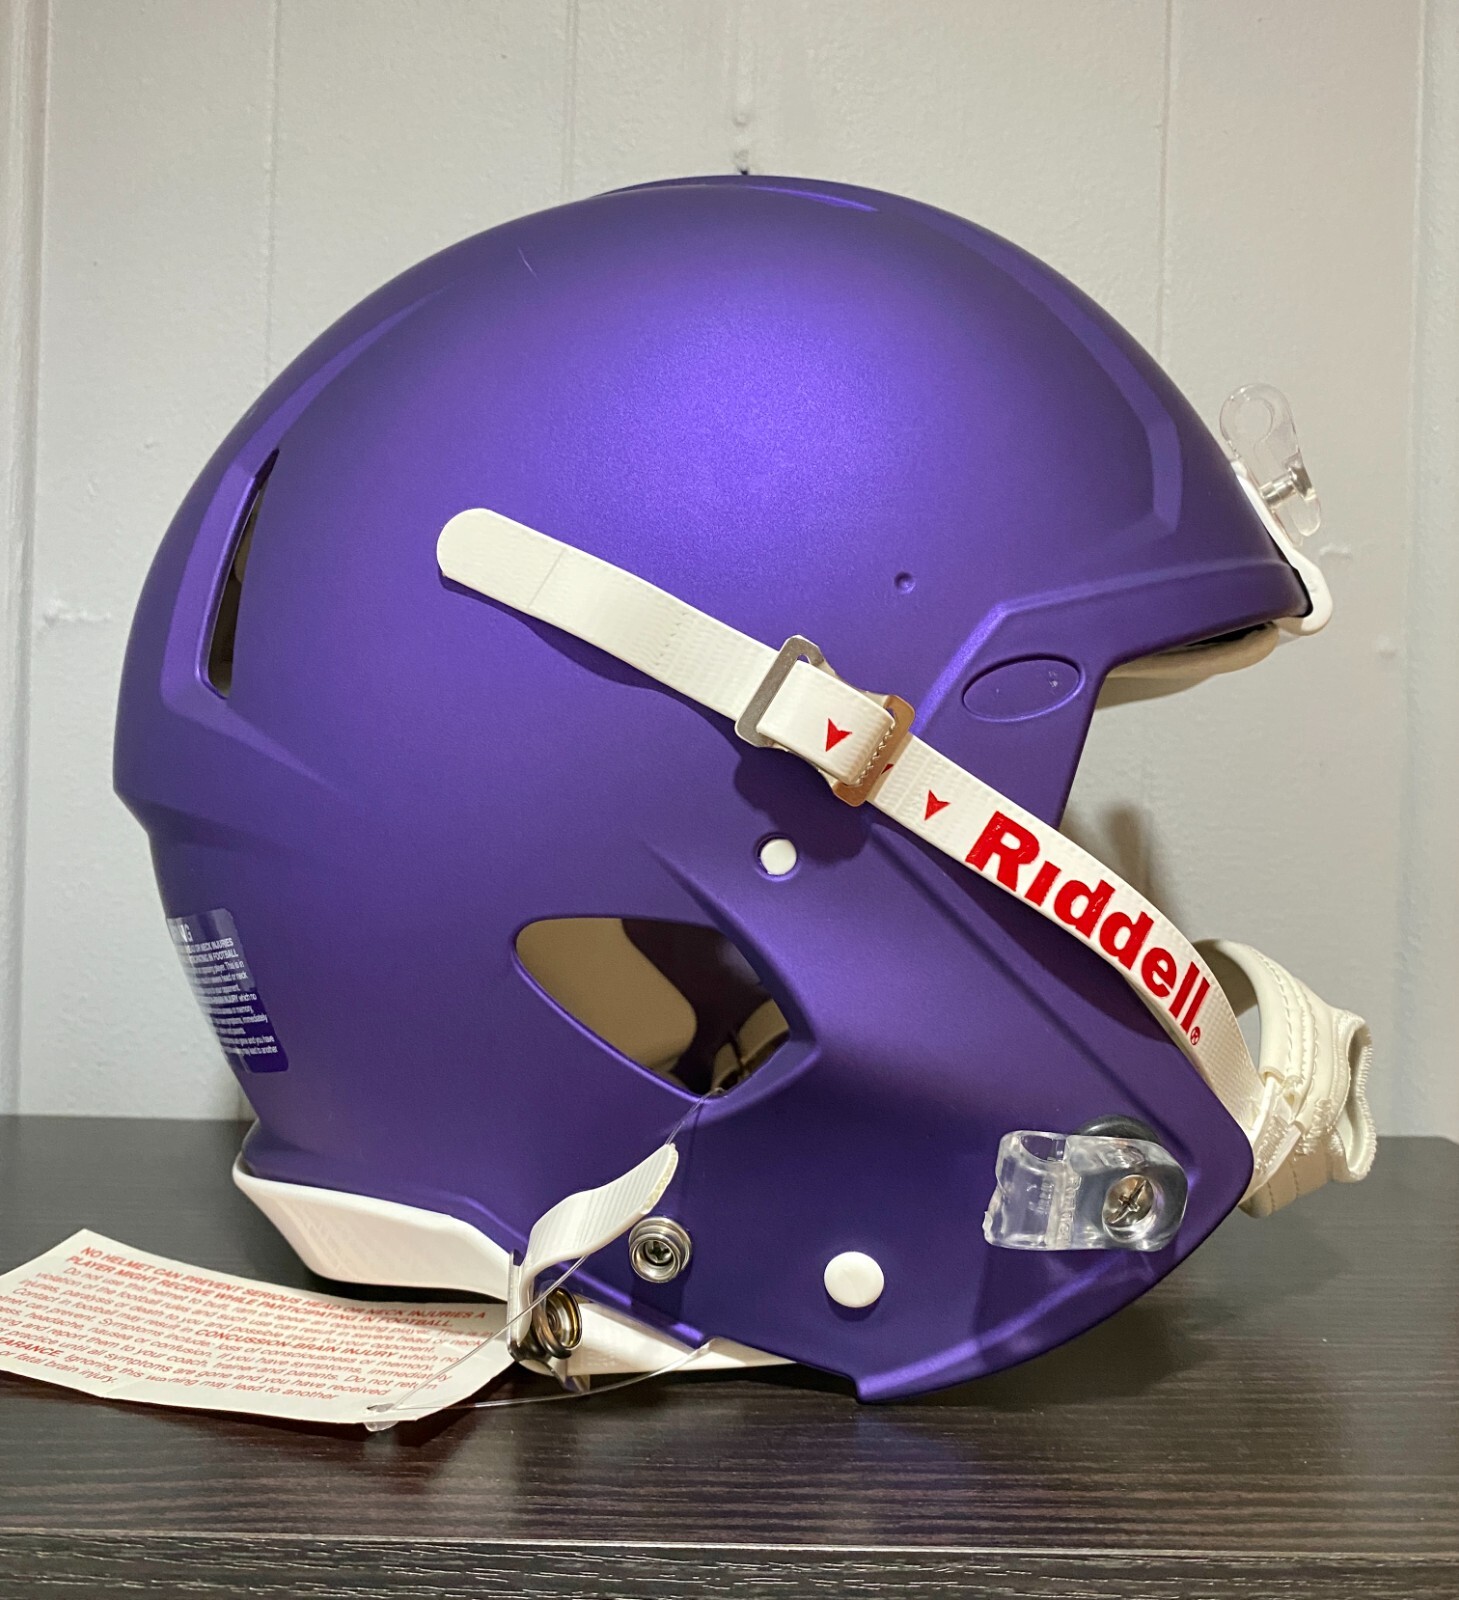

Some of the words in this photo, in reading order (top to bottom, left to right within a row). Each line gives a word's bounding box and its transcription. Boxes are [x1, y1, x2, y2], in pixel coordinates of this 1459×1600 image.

[965, 810, 1210, 1034] Riddell
[35, 1272, 82, 1286] violation
[96, 1286, 117, 1295] the
[116, 1291, 163, 1305] football
[192, 1309, 218, 1317] and
[217, 1314, 247, 1322] such
[248, 1319, 272, 1327] use
[273, 1323, 298, 1331] can
[299, 1327, 336, 1335] result
[351, 1332, 395, 1340] severe
[397, 1335, 433, 1345] head
[63, 1267, 81, 1276] Do
[81, 1272, 104, 1281] not
[101, 1278, 125, 1286] use
[124, 1282, 147, 1292] this
[147, 1287, 189, 1301] helmet
[273, 1314, 311, 1323] spear
[329, 1322, 389, 1333] opposing
[66, 1255, 116, 1273] PLAYER
[114, 1269, 159, 1283] MIGHT
[156, 1279, 215, 1296] RECEIVE
[214, 1292, 259, 1305] WHILE
[257, 1301, 358, 1320] PARTICIPATING
[377, 1316, 453, 1327] FOOTBALL.
[80, 1246, 103, 1258] NO
[101, 1254, 156, 1271] HELMET
[153, 1268, 183, 1279] CAN
[181, 1275, 244, 1292] PREVENT
[242, 1289, 302, 1304] SERIOUS
[302, 1301, 341, 1311] HEAD
[365, 1308, 404, 1316] NECK
[407, 1309, 475, 1319] INJURIES
[476, 1311, 486, 1319] A
[12, 1288, 60, 1302] Contact
[71, 1301, 119, 1316] football
[117, 1312, 145, 1322] may
[143, 1319, 181, 1329] result
[340, 1348, 399, 1358] INJURY
[399, 1353, 438, 1361] which
[25, 1302, 50, 1310] can
[98, 1318, 164, 1337] Symptoms
[215, 1343, 243, 1352] loss
[260, 1349, 358, 1364] consciousness
[59, 1289, 114, 1305] paralysis
[129, 1305, 164, 1316] death
[177, 1317, 204, 1325] you
[203, 1321, 232, 1329] and
[228, 1326, 284, 1338] possible
[285, 1334, 320, 1343] injury
[87, 1327, 134, 1340] nausea
[226, 1355, 255, 1363] you
[255, 1357, 289, 1366] have
[4, 1330, 59, 1345] practice
[58, 1342, 91, 1352] until
[104, 1353, 173, 1373] symptoms
[194, 1371, 233, 1379] gone
[233, 1374, 265, 1382] and
[290, 1380, 327, 1389] have
[326, 1384, 392, 1396] received
[15, 1353, 48, 1365] fatal
[44, 1360, 80, 1373] brain
[21, 1323, 51, 1331] and
[47, 1328, 88, 1340] report
[86, 1336, 120, 1348] them
[120, 1344, 136, 1352] to
[132, 1348, 168, 1358] your
[213, 1362, 258, 1371] trainer
[344, 1375, 366, 1383] Do
[368, 1378, 394, 1387] not
[63, 1354, 119, 1372] Ignoring
[118, 1368, 145, 1378] this
[199, 1380, 233, 1389] may
[231, 1382, 266, 1392] lead
[282, 1389, 339, 1400] another
